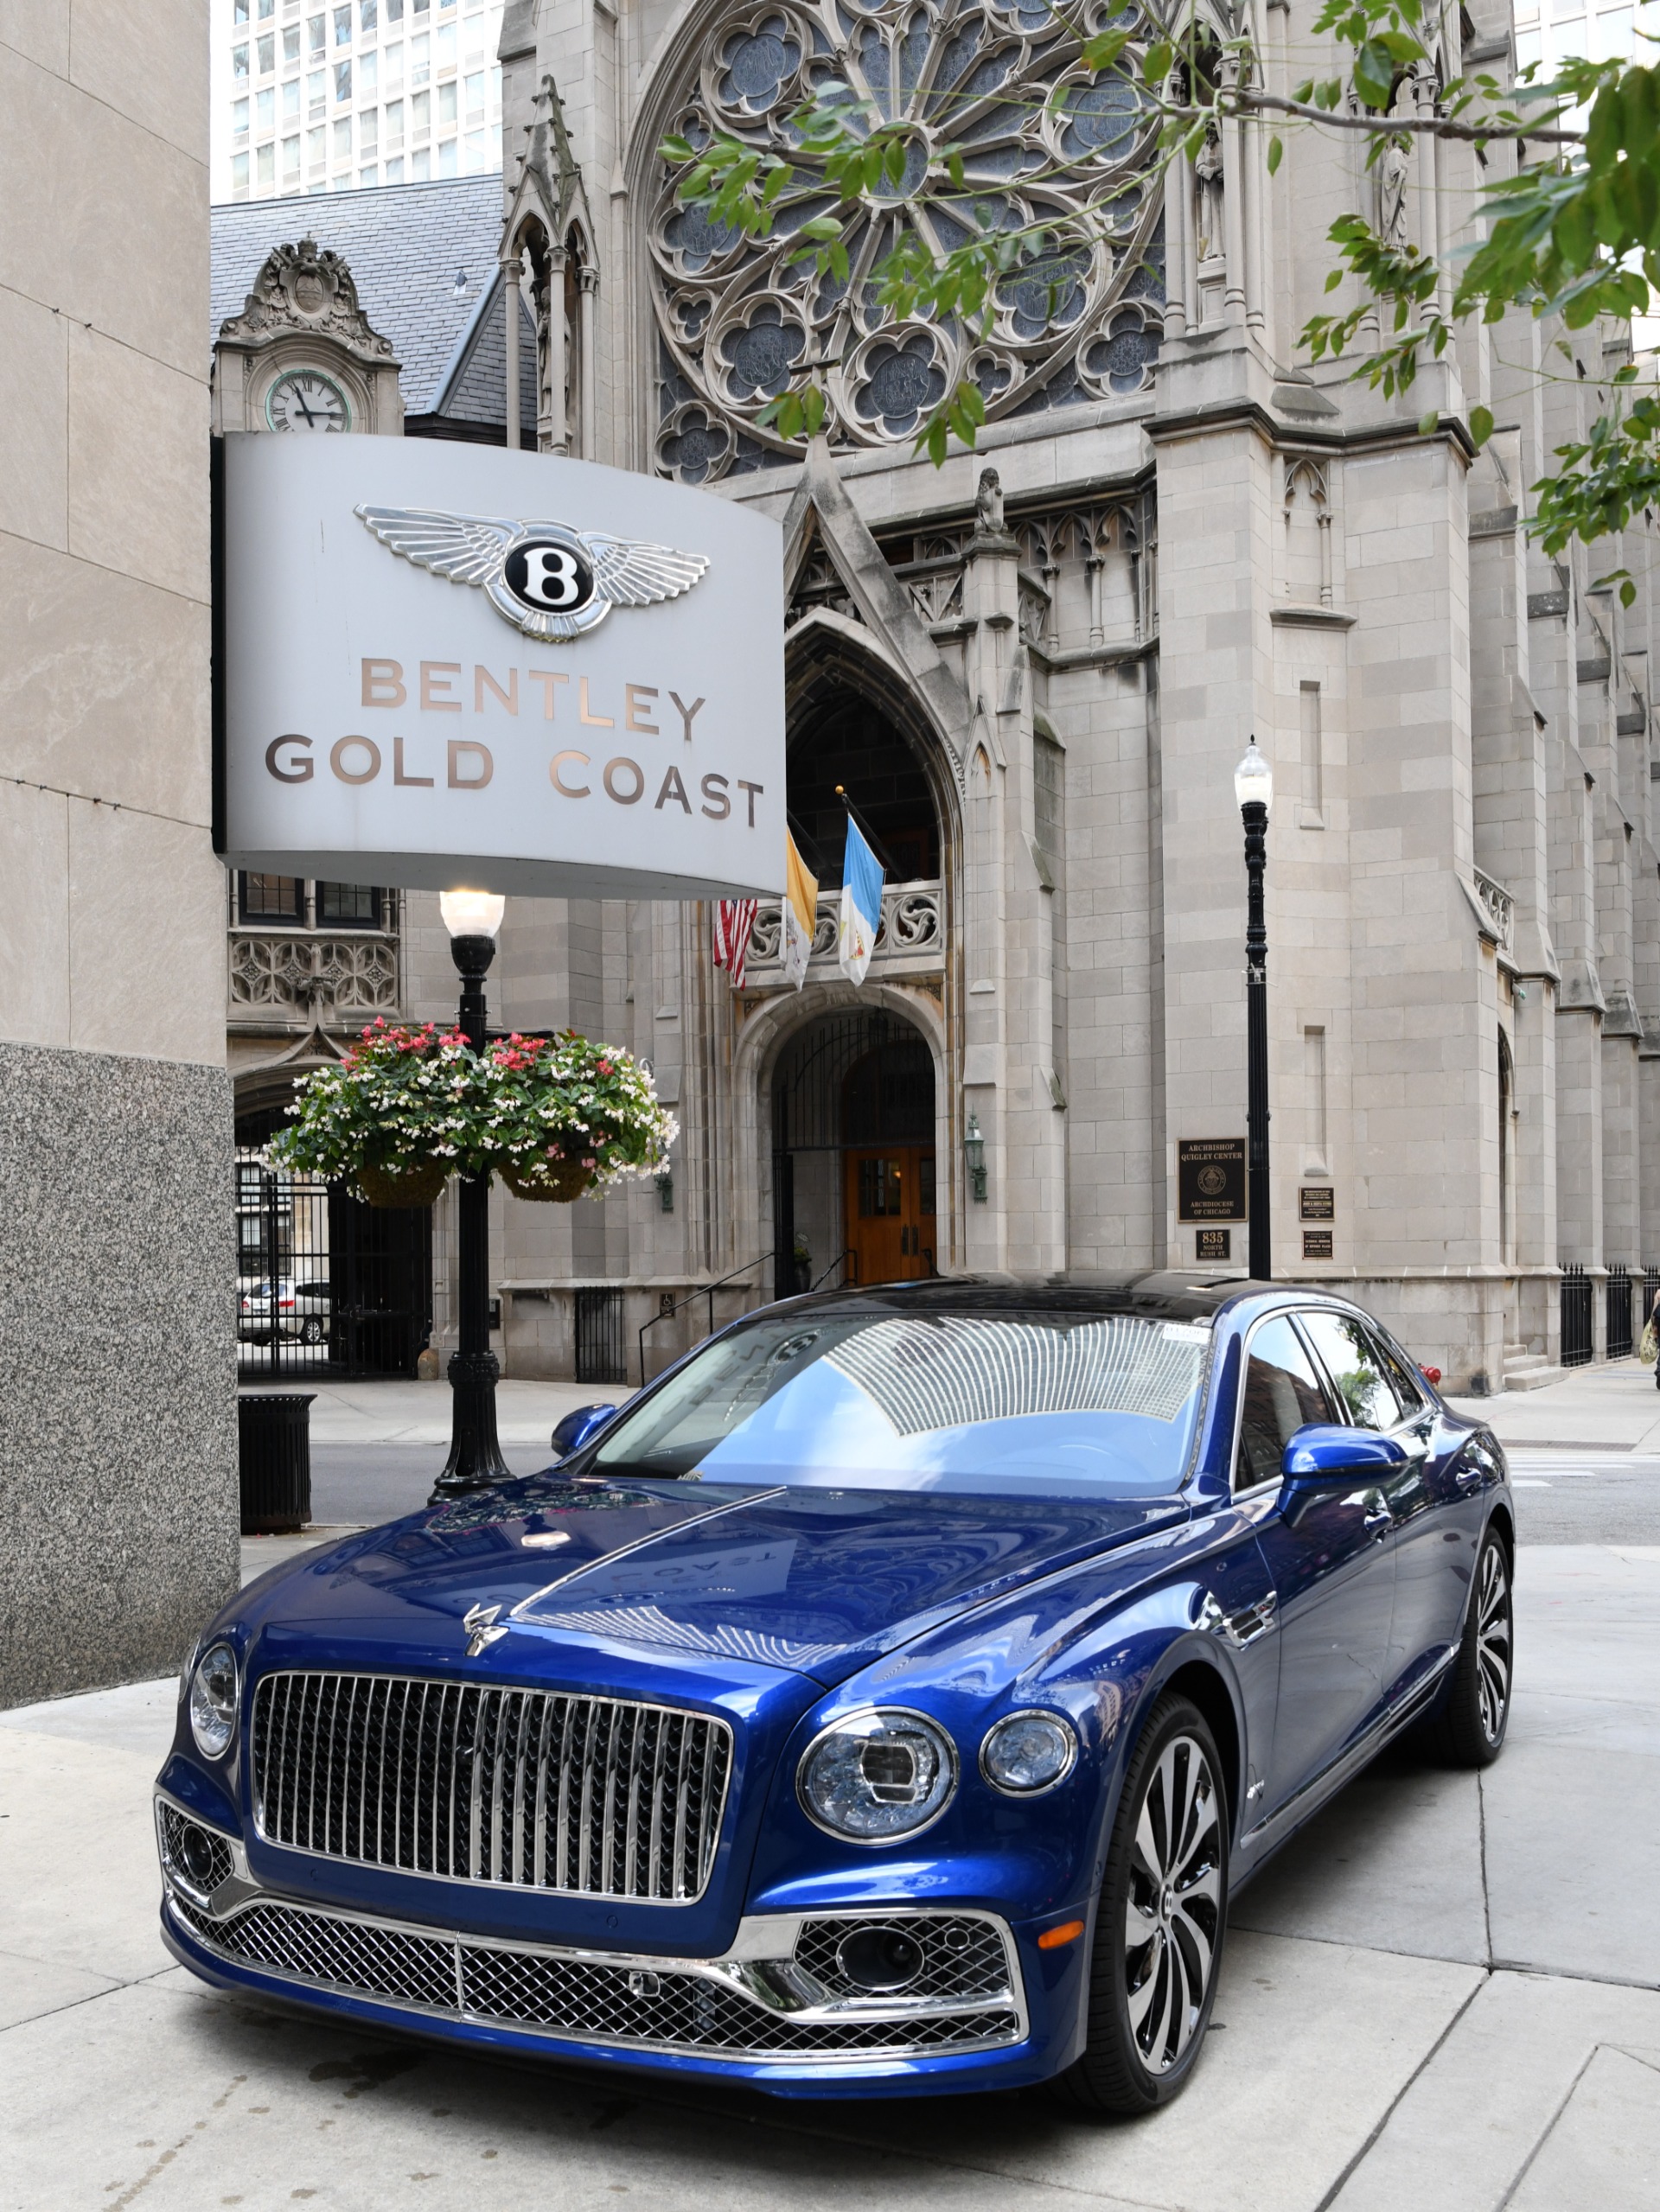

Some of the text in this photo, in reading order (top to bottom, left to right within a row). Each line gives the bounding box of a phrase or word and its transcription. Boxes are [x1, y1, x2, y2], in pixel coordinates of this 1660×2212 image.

[302, 379, 313, 393] XII
[523, 547, 579, 606] B
[361, 657, 706, 742] BENTLEY
[265, 733, 764, 829] GOLD COAST
[1188, 1144, 1235, 1152] ARCHBISHOP
[1181, 1151, 1243, 1163] QUIGLEY CENTER
[1202, 1232, 1224, 1244] 835
